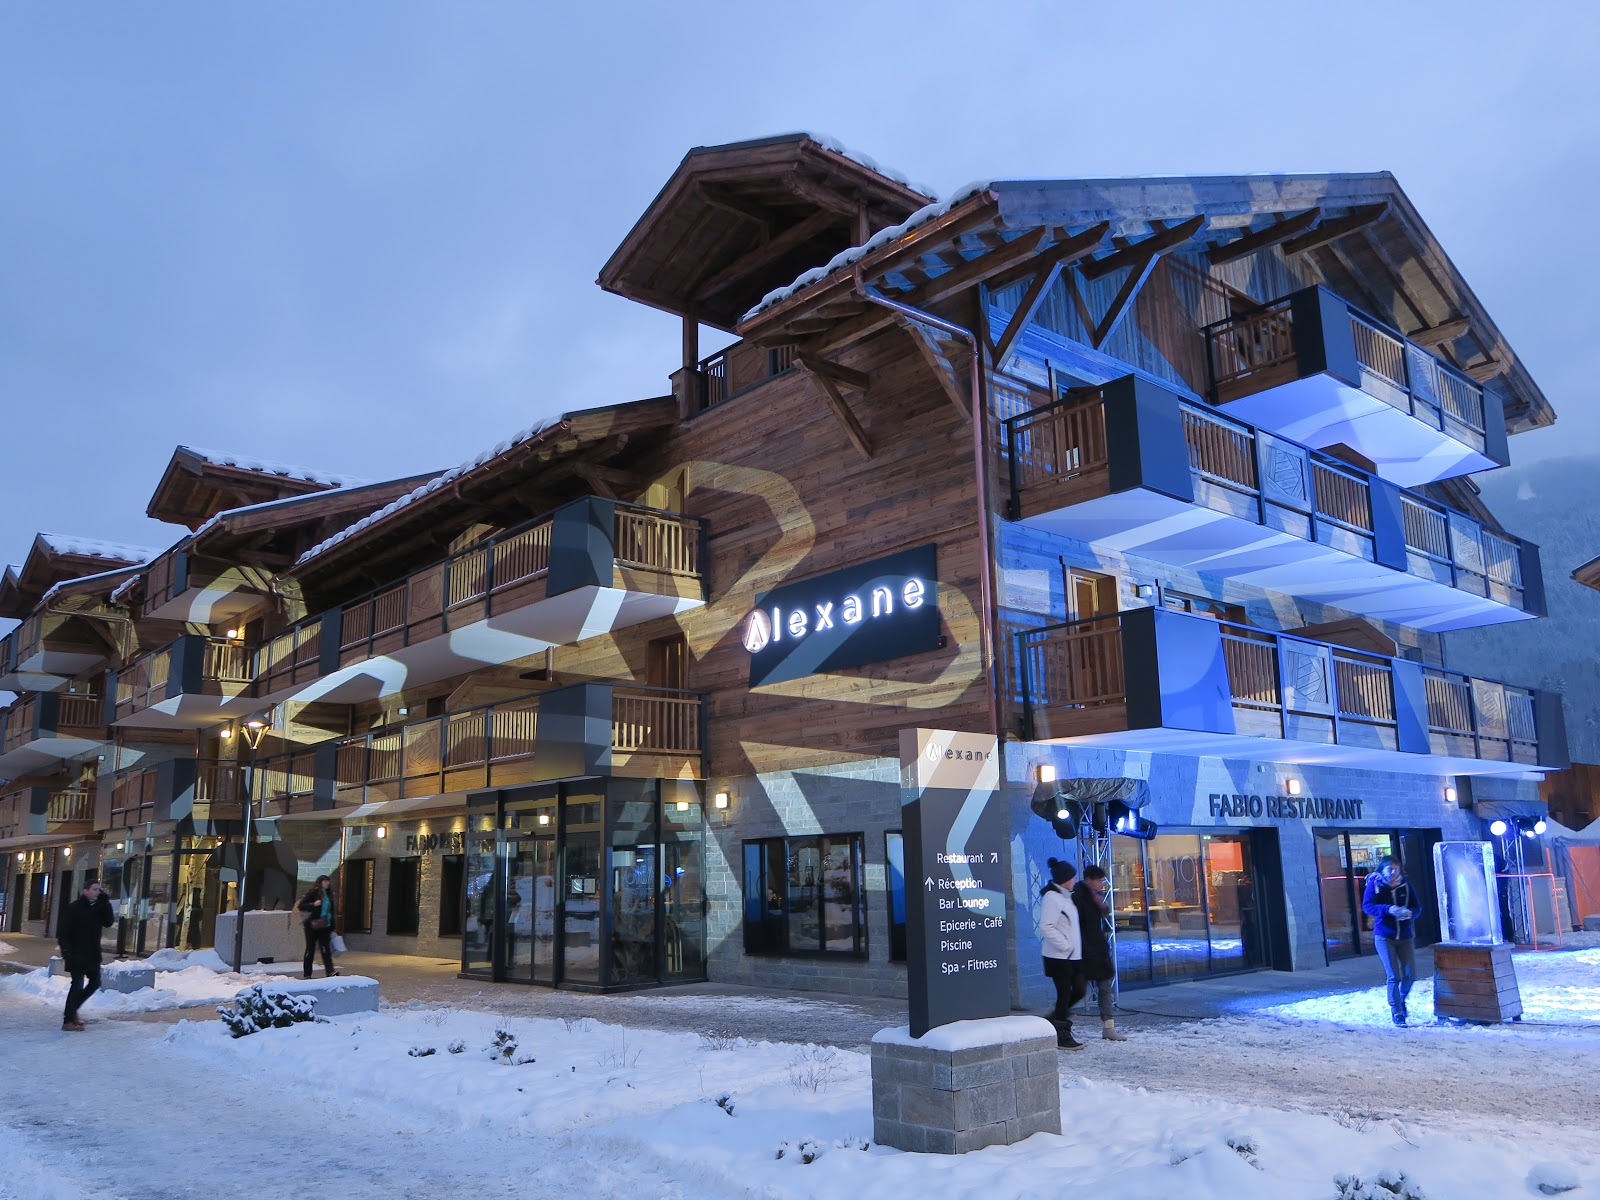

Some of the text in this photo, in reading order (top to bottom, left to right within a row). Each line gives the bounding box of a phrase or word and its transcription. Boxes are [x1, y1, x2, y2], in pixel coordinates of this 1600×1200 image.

[741, 577, 926, 654] Alexane
[925, 742, 993, 762] Alexane
[1209, 793, 1363, 819] FABIO RESTAURANT
[936, 853, 984, 864] Restaurant
[938, 878, 983, 891] Réception
[939, 897, 990, 910] Bar Lounge
[940, 918, 976, 933] Epicerie
[983, 915, 1003, 929] Café
[940, 938, 973, 952] Piscine
[941, 962, 959, 976] Spa
[967, 958, 998, 971] Fitness
